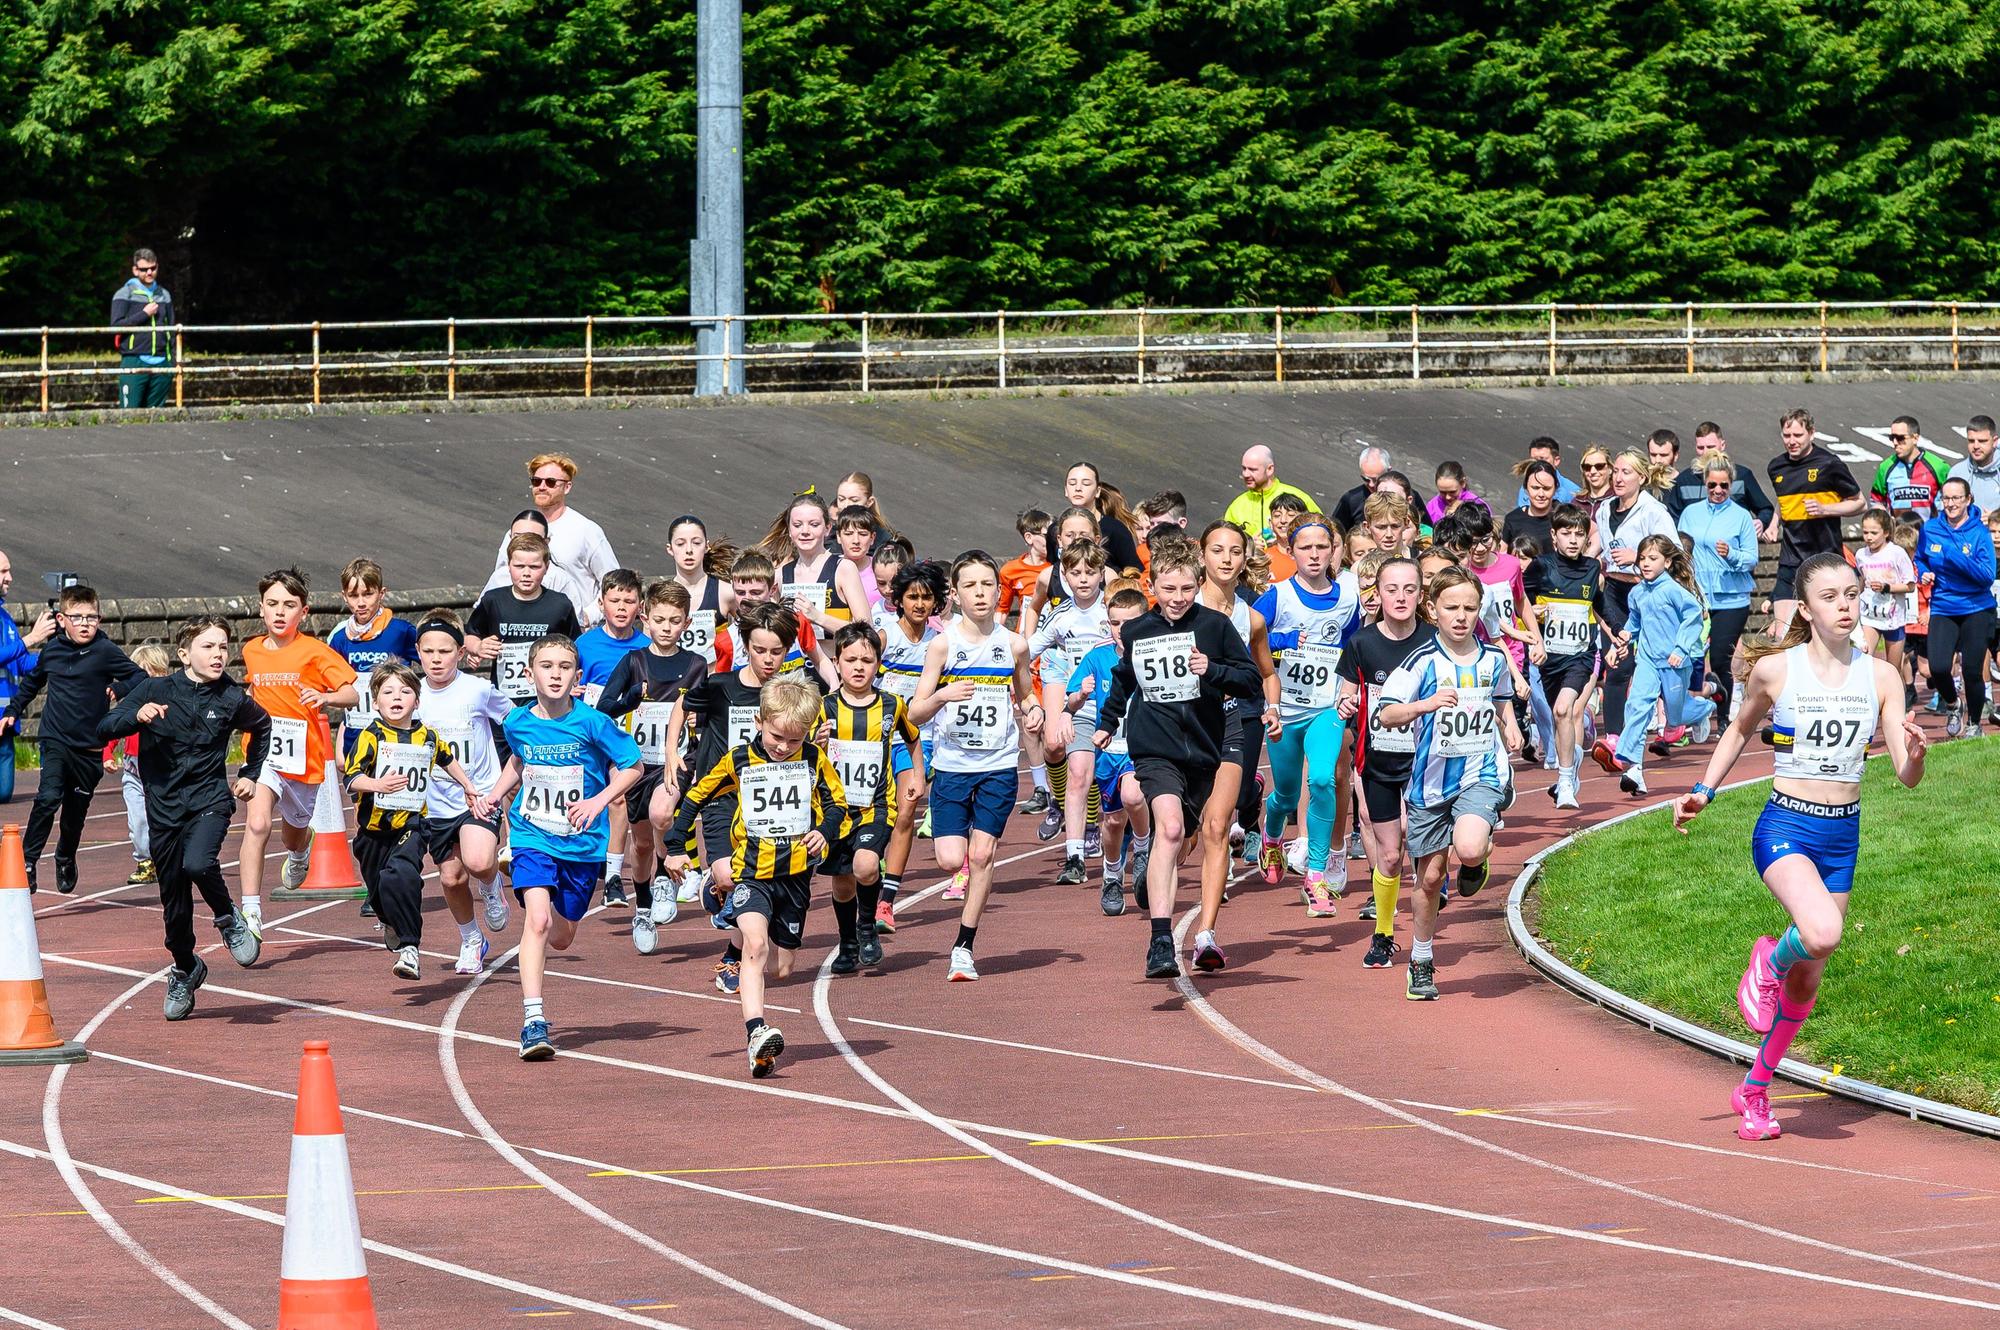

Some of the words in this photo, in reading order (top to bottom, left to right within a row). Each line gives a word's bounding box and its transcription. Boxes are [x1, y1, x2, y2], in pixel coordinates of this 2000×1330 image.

[508, 623, 549, 632] FITNESS
[1545, 620, 1588, 641] 6140
[1135, 639, 1156, 647] ROUND
[1143, 655, 1187, 681] 518
[1287, 662, 1328, 687] 489
[1797, 695, 1824, 703] ROUND
[1841, 695, 1868, 704] HOUSES
[283, 720, 305, 728] HOUSES
[956, 705, 997, 727] 543
[1440, 708, 1494, 738] 5042
[633, 722, 687, 747] 61
[1806, 719, 1860, 748] 497
[533, 742, 580, 755] FITNESS
[743, 766, 766, 775] ROUND
[779, 763, 806, 771] HOUSES
[753, 785, 801, 812] 544
[1777, 795, 1845, 816] ARMOUR
